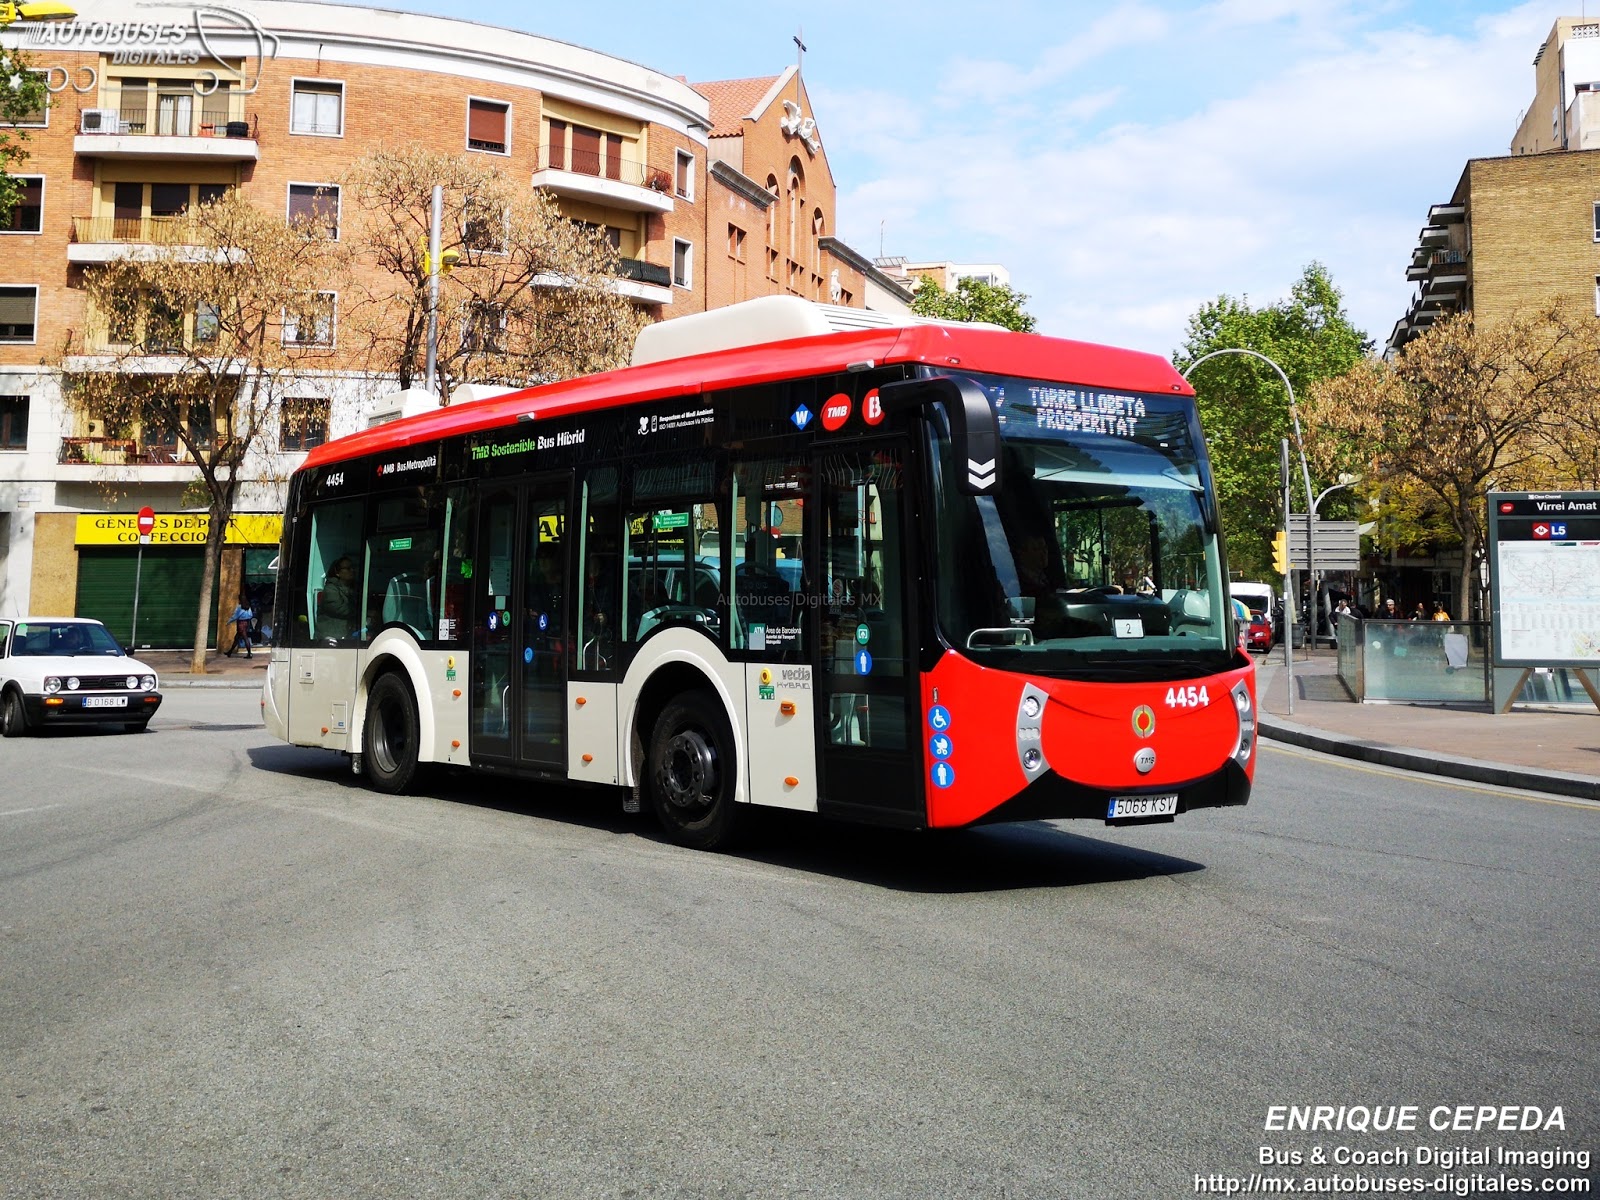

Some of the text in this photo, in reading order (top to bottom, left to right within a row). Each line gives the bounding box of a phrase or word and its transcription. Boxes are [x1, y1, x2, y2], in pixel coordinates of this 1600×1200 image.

[1029, 386, 1146, 417] TORRE LLOBETA
[795, 410, 808, 425] W
[827, 405, 848, 418] TMB
[1036, 408, 1138, 437] PROSPERITAT
[472, 445, 490, 460] TMB
[491, 438, 536, 457] Sostenible
[537, 435, 555, 450] Bus
[382, 463, 395, 475] AMB
[326, 472, 344, 487] 4454
[1536, 501, 1565, 511] Virrei
[1567, 501, 1598, 511] Amat
[95, 515, 237, 529] GÈNEES DE PT
[1551, 525, 1566, 535] L5
[753, 626, 765, 634] ATM
[781, 626, 802, 634] Barcelona
[1125, 623, 1132, 635] 2
[781, 667, 811, 681] vectia
[776, 681, 811, 690] HYBRID
[1165, 685, 1210, 708] 4454
[1140, 756, 1155, 764] TMB
[1117, 796, 1178, 815] 5068 KSV
